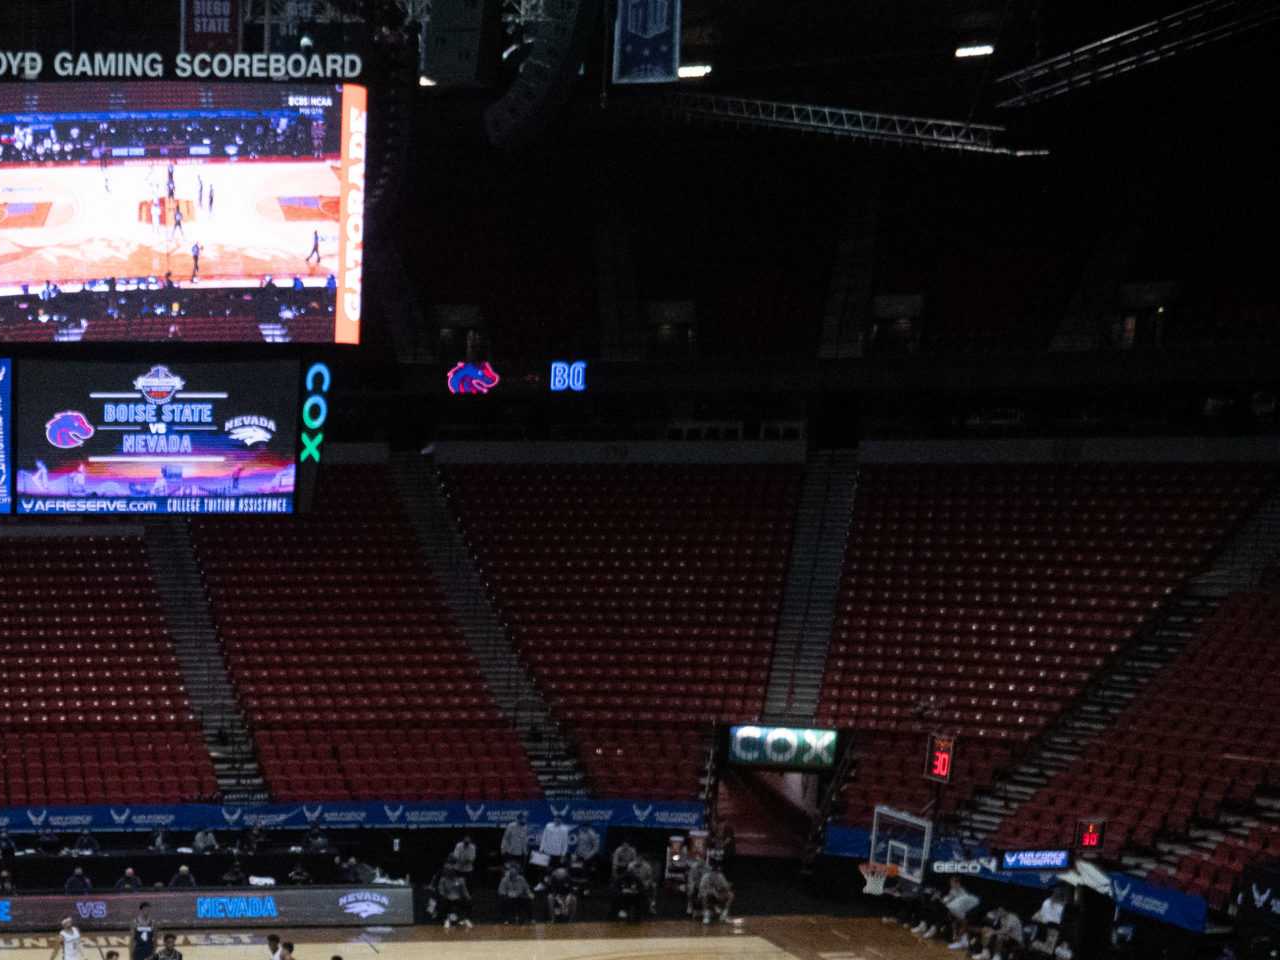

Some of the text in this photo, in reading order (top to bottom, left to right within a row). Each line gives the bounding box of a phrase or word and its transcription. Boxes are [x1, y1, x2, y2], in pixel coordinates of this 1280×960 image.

[54, 51, 163, 78] GAMING
[175, 51, 362, 79] SCOREBOARD
[344, 107, 366, 322] GATORADE
[104, 404, 213, 422] BOISE STATE
[300, 362, 331, 463] COX
[149, 423, 167, 434] VS
[224, 415, 277, 433] NEVADA
[123, 434, 192, 453] NEVADA
[33, 498, 287, 512] AFRESERVE.com COLLEGE TUITION ASSISTANCE
[735, 726, 836, 763] COX
[932, 751, 949, 776] 30
[933, 861, 981, 873] GEICO
[196, 895, 278, 919] NEVADA
[338, 891, 390, 907] NEVADA
[76, 901, 106, 919] VS
